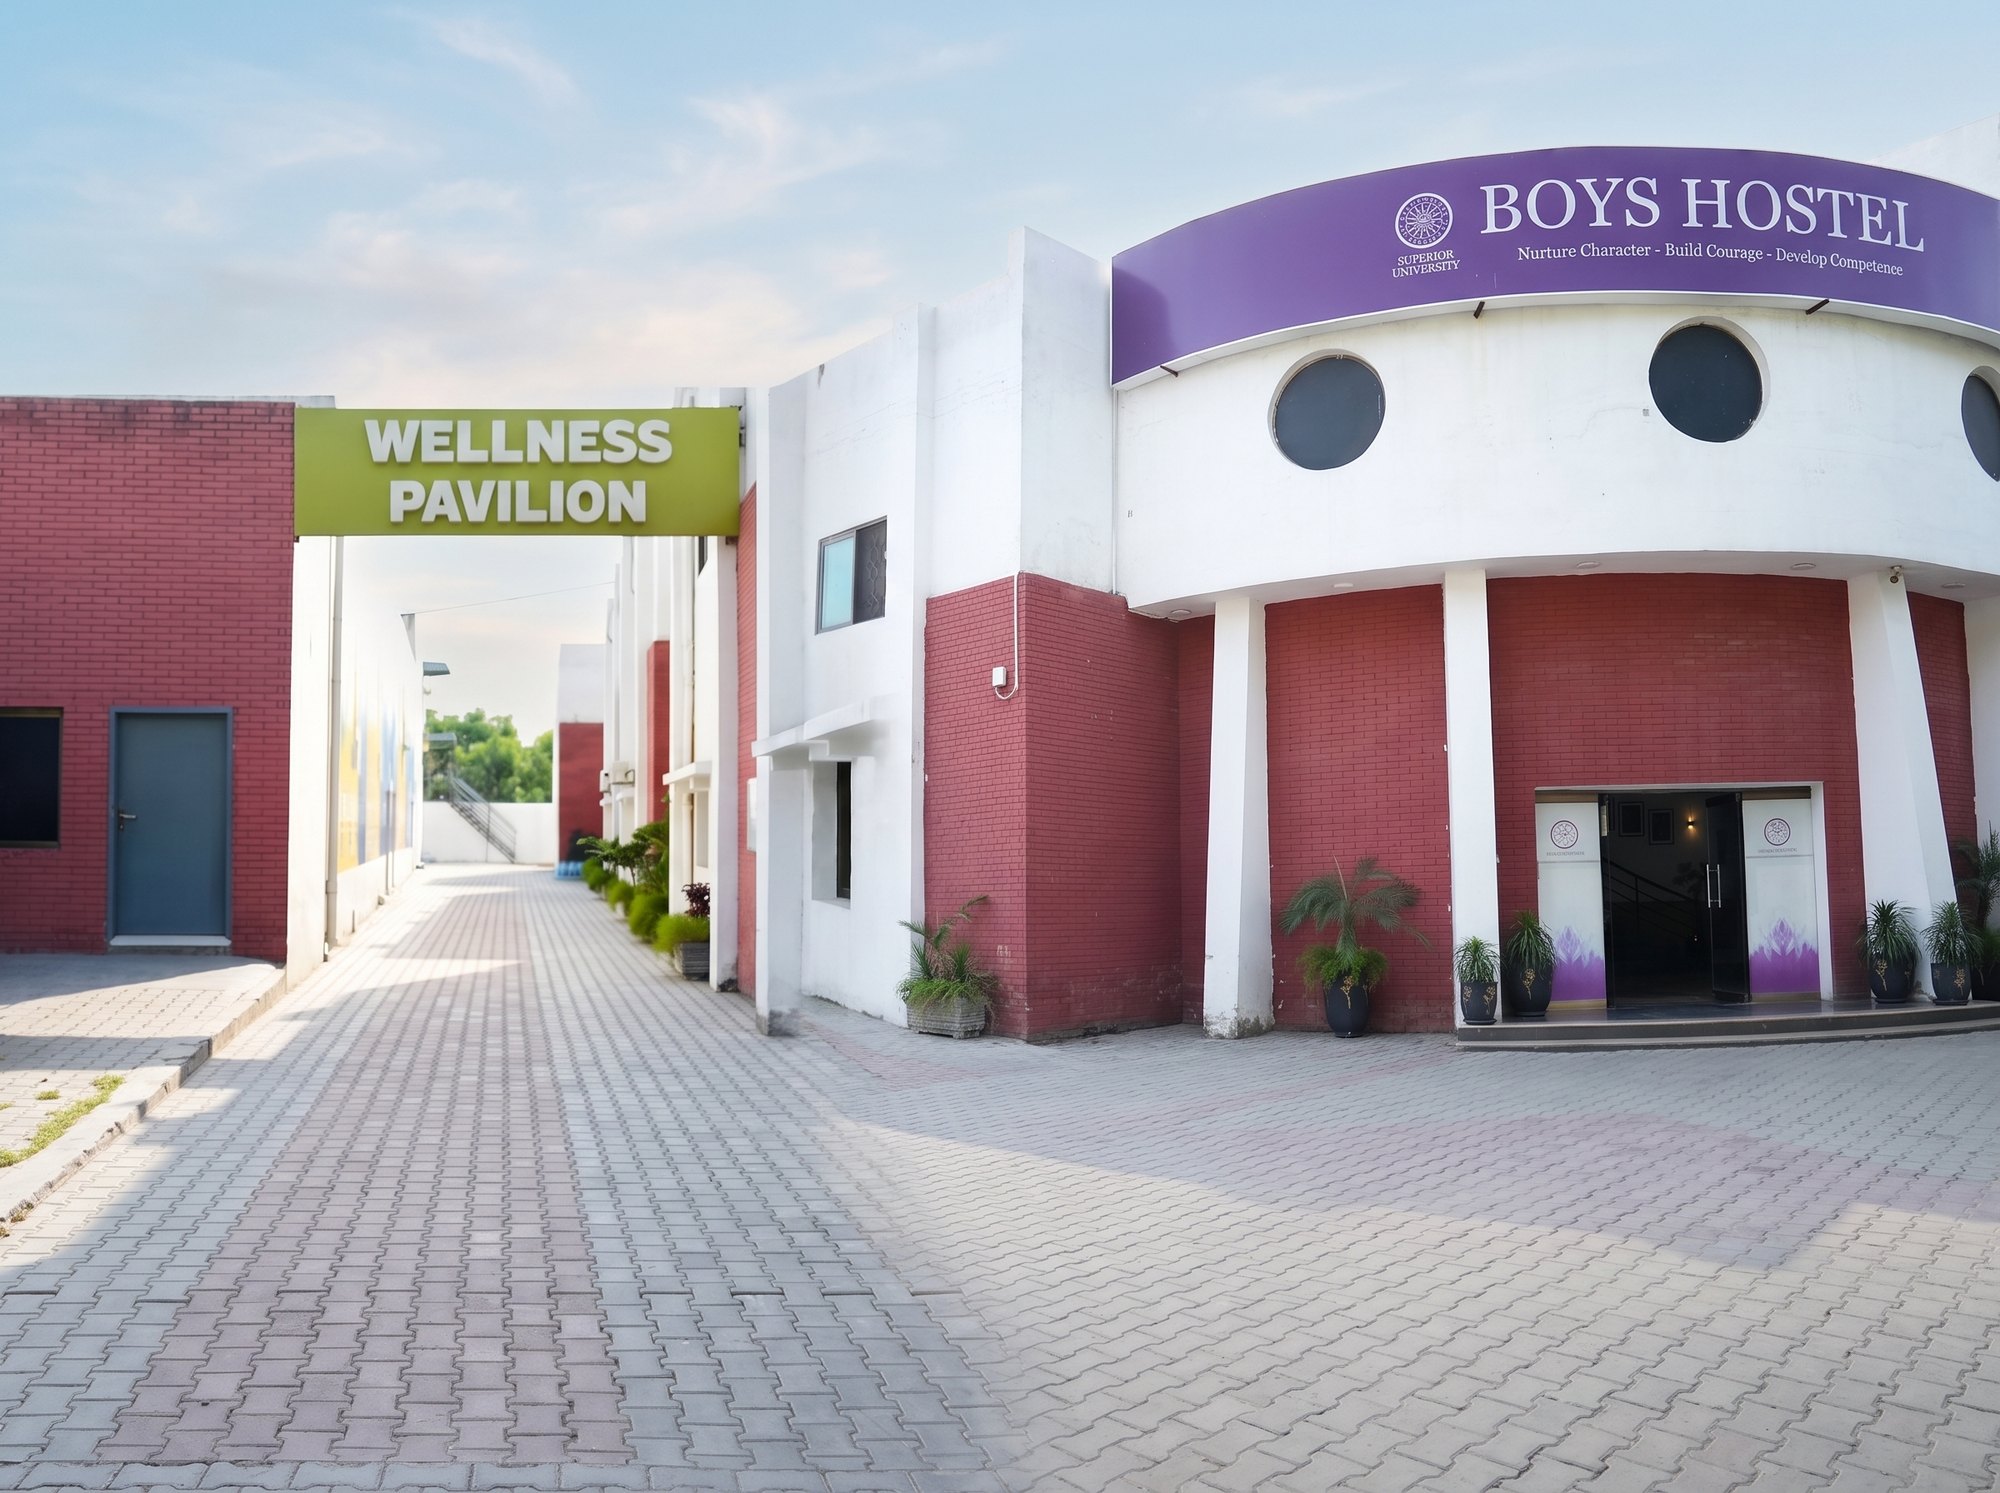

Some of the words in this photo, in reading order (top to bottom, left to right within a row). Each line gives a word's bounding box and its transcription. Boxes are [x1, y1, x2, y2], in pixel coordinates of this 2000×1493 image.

[1480, 176, 1661, 234] BOYS
[1681, 178, 1925, 252] HOSTEL
[1392, 259, 1461, 278] UNIVERSITY
[1397, 249, 1455, 266] SUPERIOR
[1518, 246, 1577, 261] Nurture
[1580, 242, 1651, 258] Character
[1665, 243, 1703, 257] Build
[1706, 243, 1763, 262] Courage
[1776, 247, 1828, 268] Develop
[1830, 253, 1904, 276] Competence
[364, 418, 673, 464] WELLNESS
[389, 480, 647, 524] PAVILION
